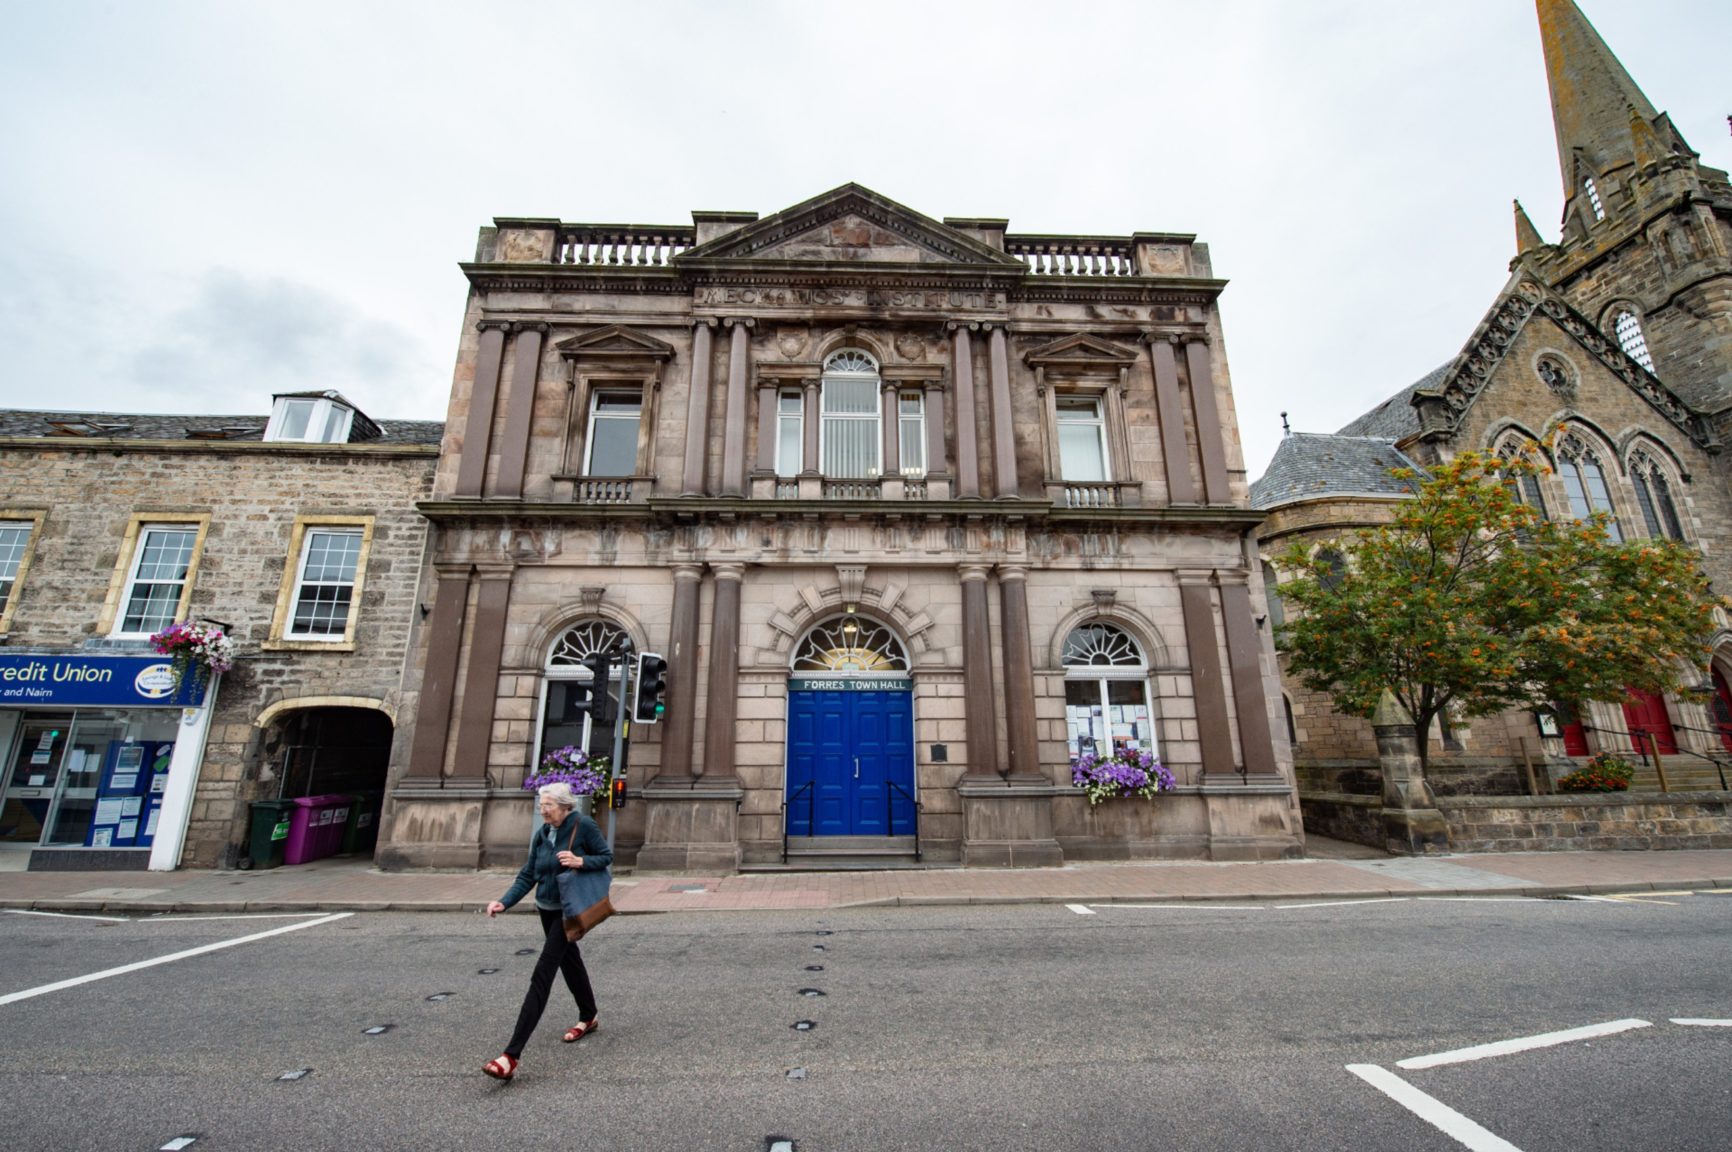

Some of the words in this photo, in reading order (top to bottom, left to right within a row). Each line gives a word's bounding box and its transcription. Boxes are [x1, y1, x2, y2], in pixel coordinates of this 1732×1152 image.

[52, 662, 113, 683] Union
[804, 681, 845, 689] FORRES
[849, 681, 878, 689] TOWN
[880, 680, 906, 689] HALL
[4, 687, 24, 696] and
[25, 687, 53, 697] Nairn
